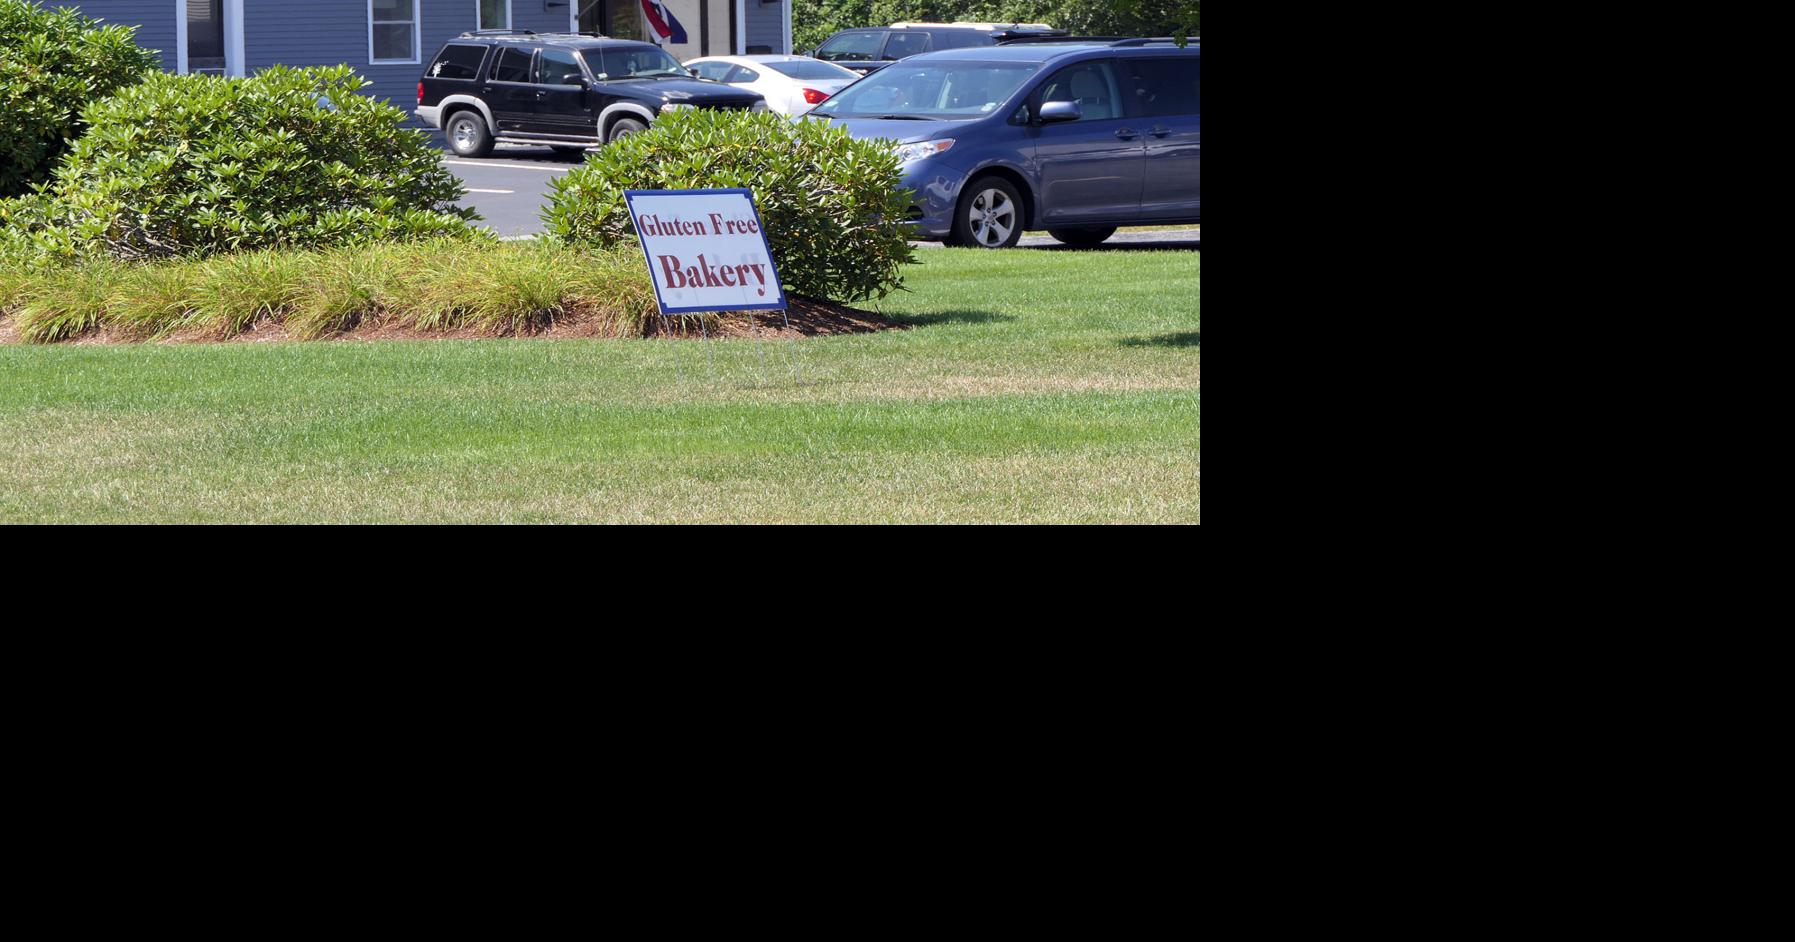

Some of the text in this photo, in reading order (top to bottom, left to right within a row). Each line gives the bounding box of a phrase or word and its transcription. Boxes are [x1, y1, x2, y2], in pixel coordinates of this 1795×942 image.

[639, 213, 758, 236] Gluten Free
[657, 253, 765, 297] Bakery
